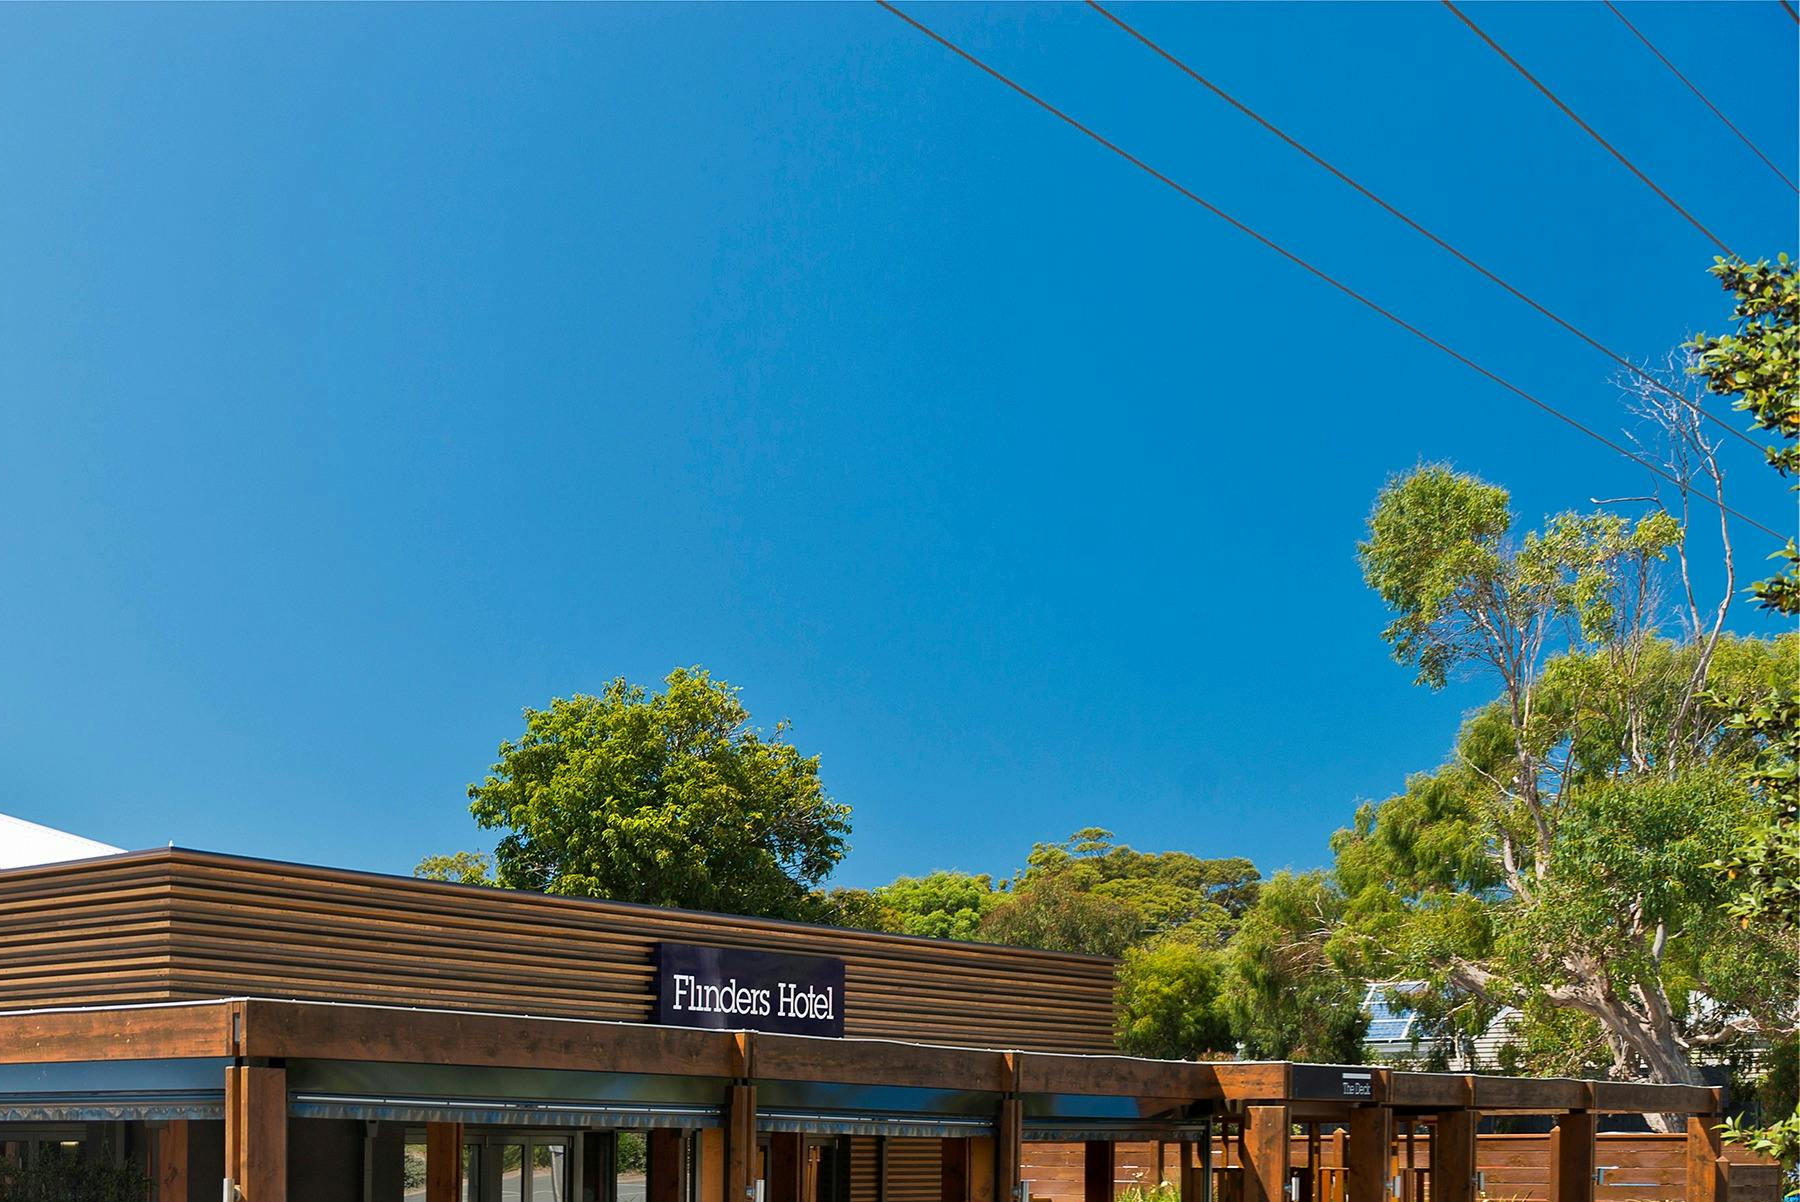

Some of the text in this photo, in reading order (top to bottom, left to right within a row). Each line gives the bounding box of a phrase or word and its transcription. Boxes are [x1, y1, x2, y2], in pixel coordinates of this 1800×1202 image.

[673, 974, 835, 1020] Flinders Hotel
[1342, 1082, 1371, 1096] The Deck
